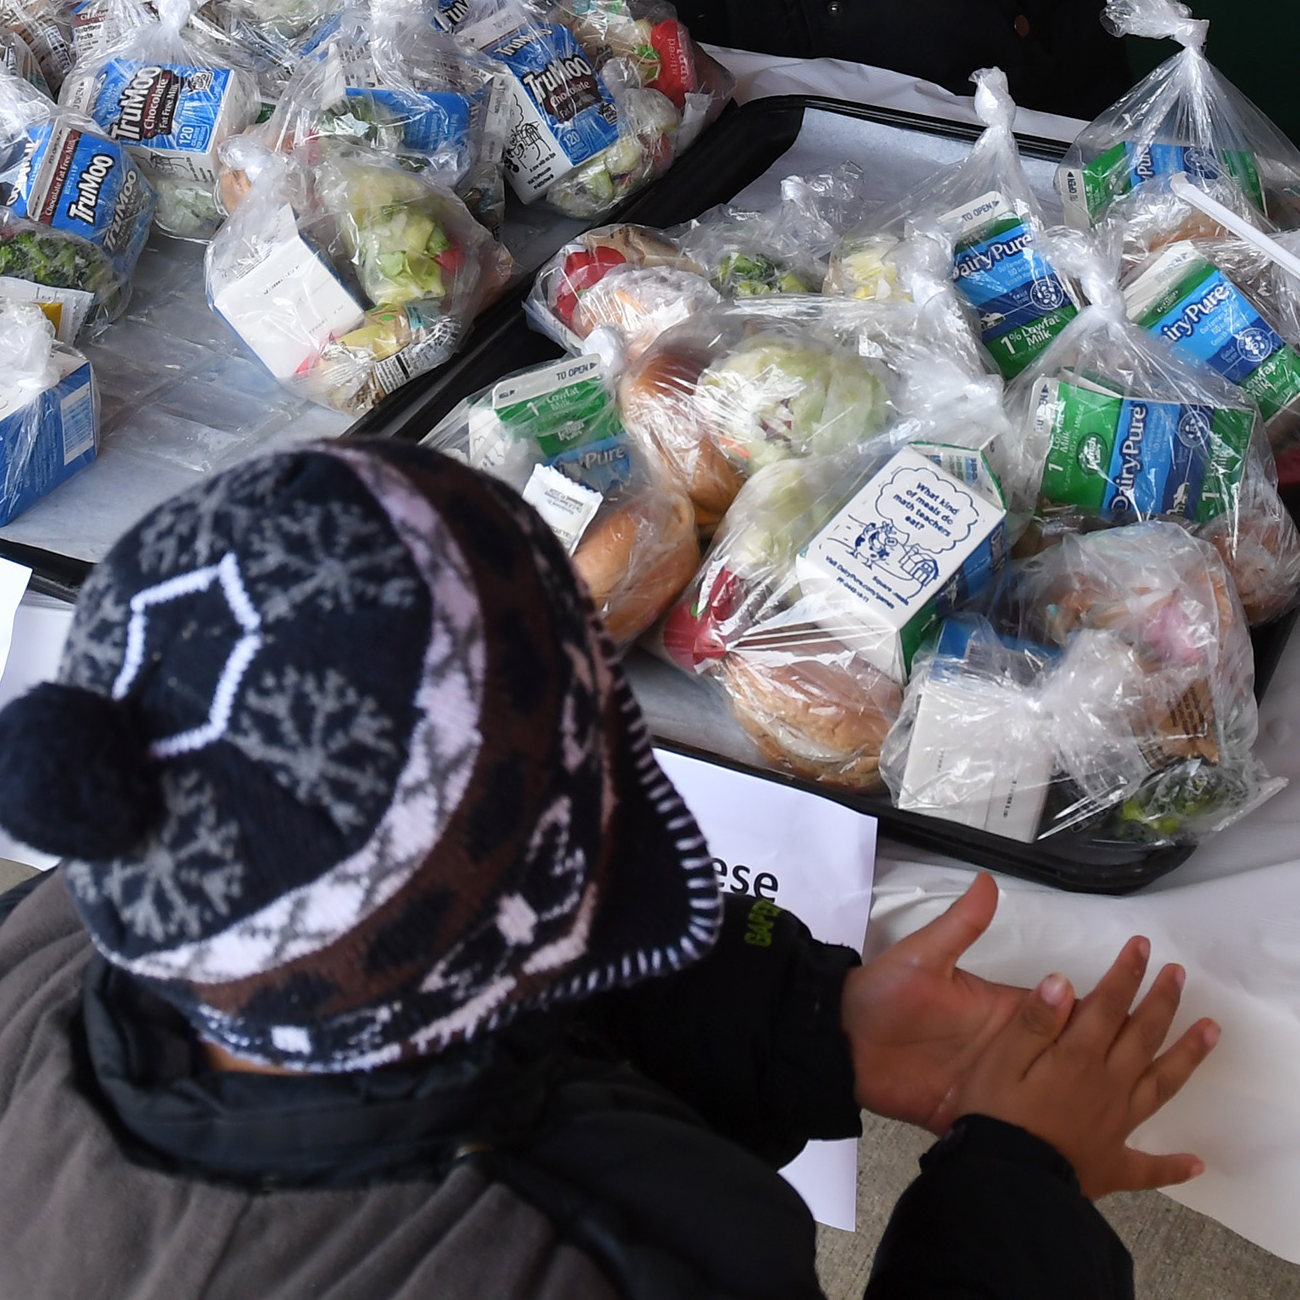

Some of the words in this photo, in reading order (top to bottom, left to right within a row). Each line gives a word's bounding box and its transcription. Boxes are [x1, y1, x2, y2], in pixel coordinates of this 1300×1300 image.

[523, 56, 592, 102] TruMoo
[111, 66, 162, 141] TruMoo
[144, 78, 168, 129] Chocolate
[179, 126, 194, 144] 120
[563, 131, 581, 147] 120
[55, 169, 66, 182] Fat
[59, 154, 72, 171] Free
[45, 181, 62, 217] Chocolate
[69, 154, 114, 225] TruMoo
[103, 170, 137, 250] TruMoo
[973, 202, 992, 218] OPEN
[1164, 284, 1230, 341] iryPure
[1001, 331, 1022, 354] 1%
[1021, 315, 1060, 338] Lowfat
[1026, 329, 1051, 347] Milk
[568, 364, 589, 378] OPEN
[1246, 361, 1276, 390] owfat
[1111, 406, 1147, 513] DairyPure
[893, 494, 915, 512] math
[915, 507, 952, 537] teachers
[906, 489, 917, 500] of
[916, 497, 941, 516] meals
[941, 513, 953, 525] do
[915, 482, 940, 500] What
[939, 496, 960, 516] kind
[905, 515, 925, 530] eat?
[825, 555, 840, 568] Visit
[872, 576, 892, 593] Square
[712, 857, 779, 903] ese
